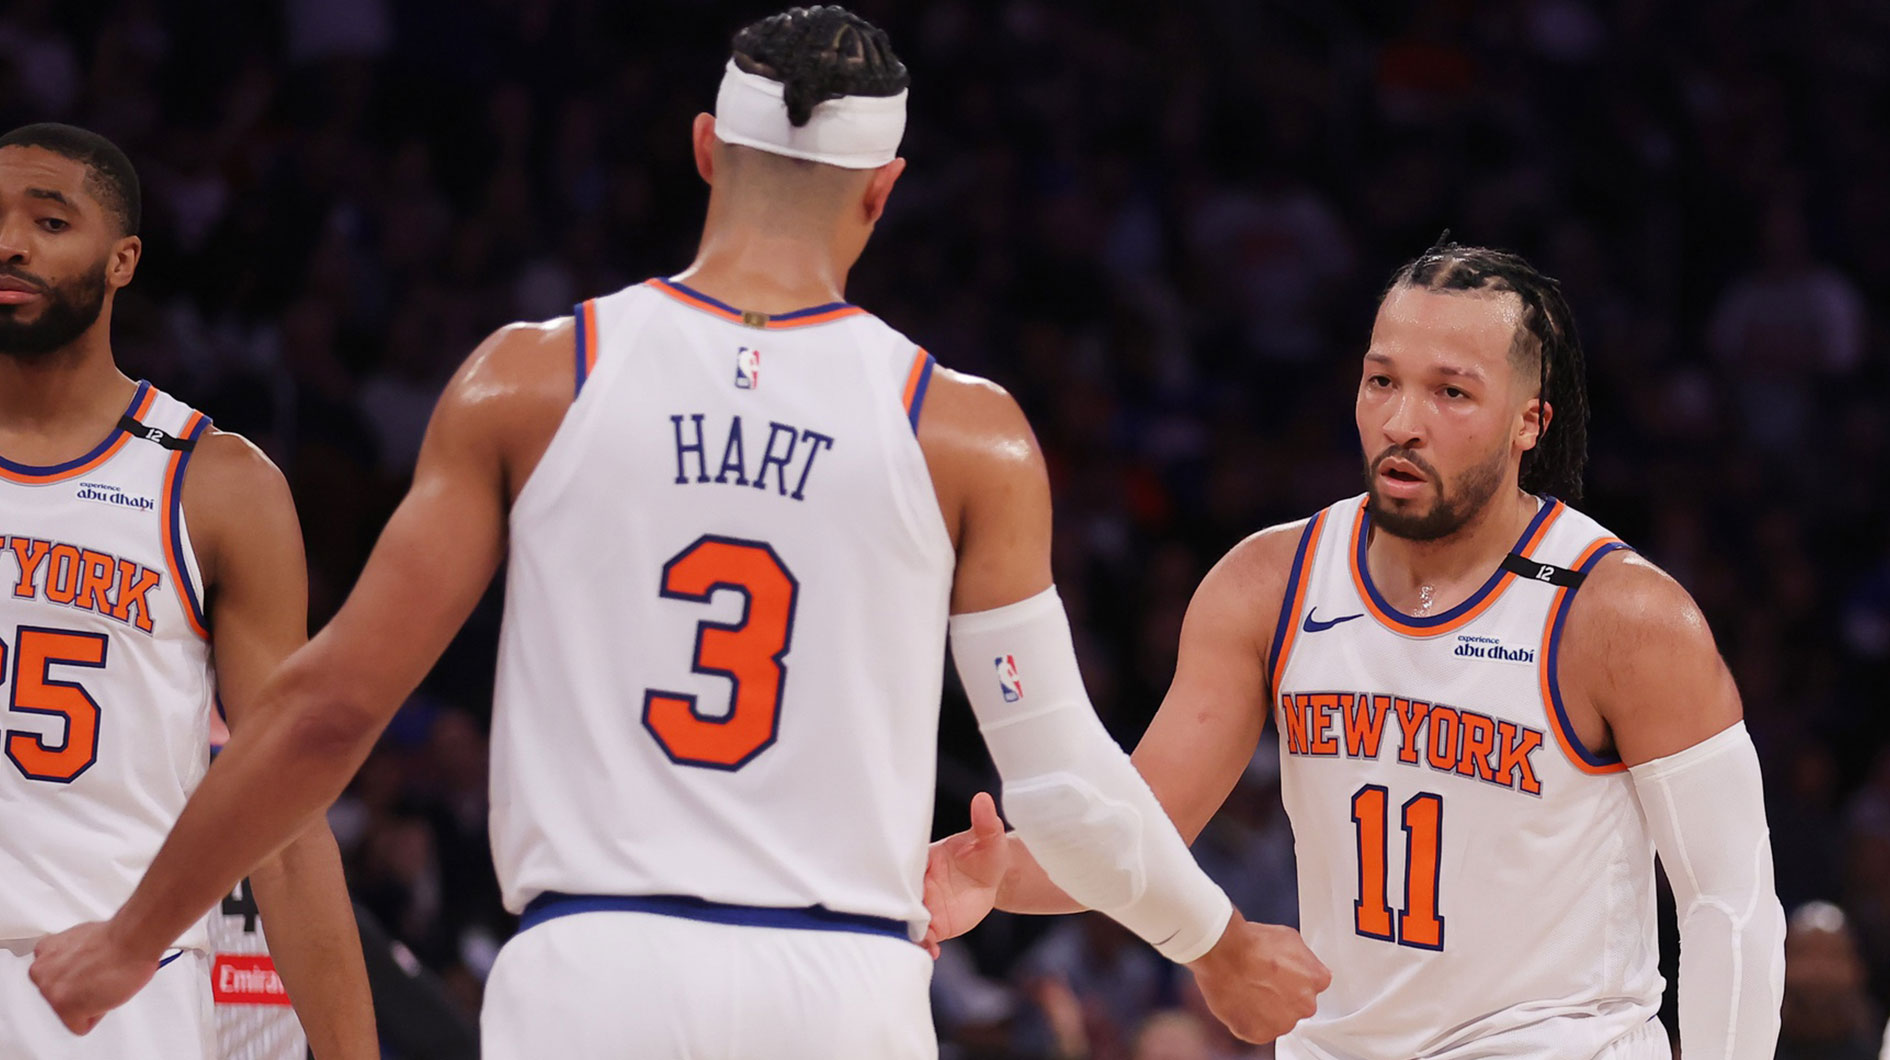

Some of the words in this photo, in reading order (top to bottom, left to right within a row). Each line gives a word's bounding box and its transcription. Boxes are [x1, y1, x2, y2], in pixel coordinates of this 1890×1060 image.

[145, 428, 164, 442] 12
[670, 414, 834, 501] HART
[77, 489, 107, 502] abu
[109, 493, 155, 510] dhabi
[79, 482, 121, 492] experience
[10, 537, 162, 635] YORK
[1535, 565, 1555, 582] 12
[642, 533, 799, 772] 3
[1454, 643, 1485, 658] abu
[1487, 646, 1535, 663] dhabi
[1457, 635, 1500, 645] experience
[0, 623, 109, 784] 5
[1282, 692, 1393, 760] NEW
[1394, 697, 1546, 798] YORK
[1351, 784, 1444, 952] 11
[219, 964, 286, 995] Emira
